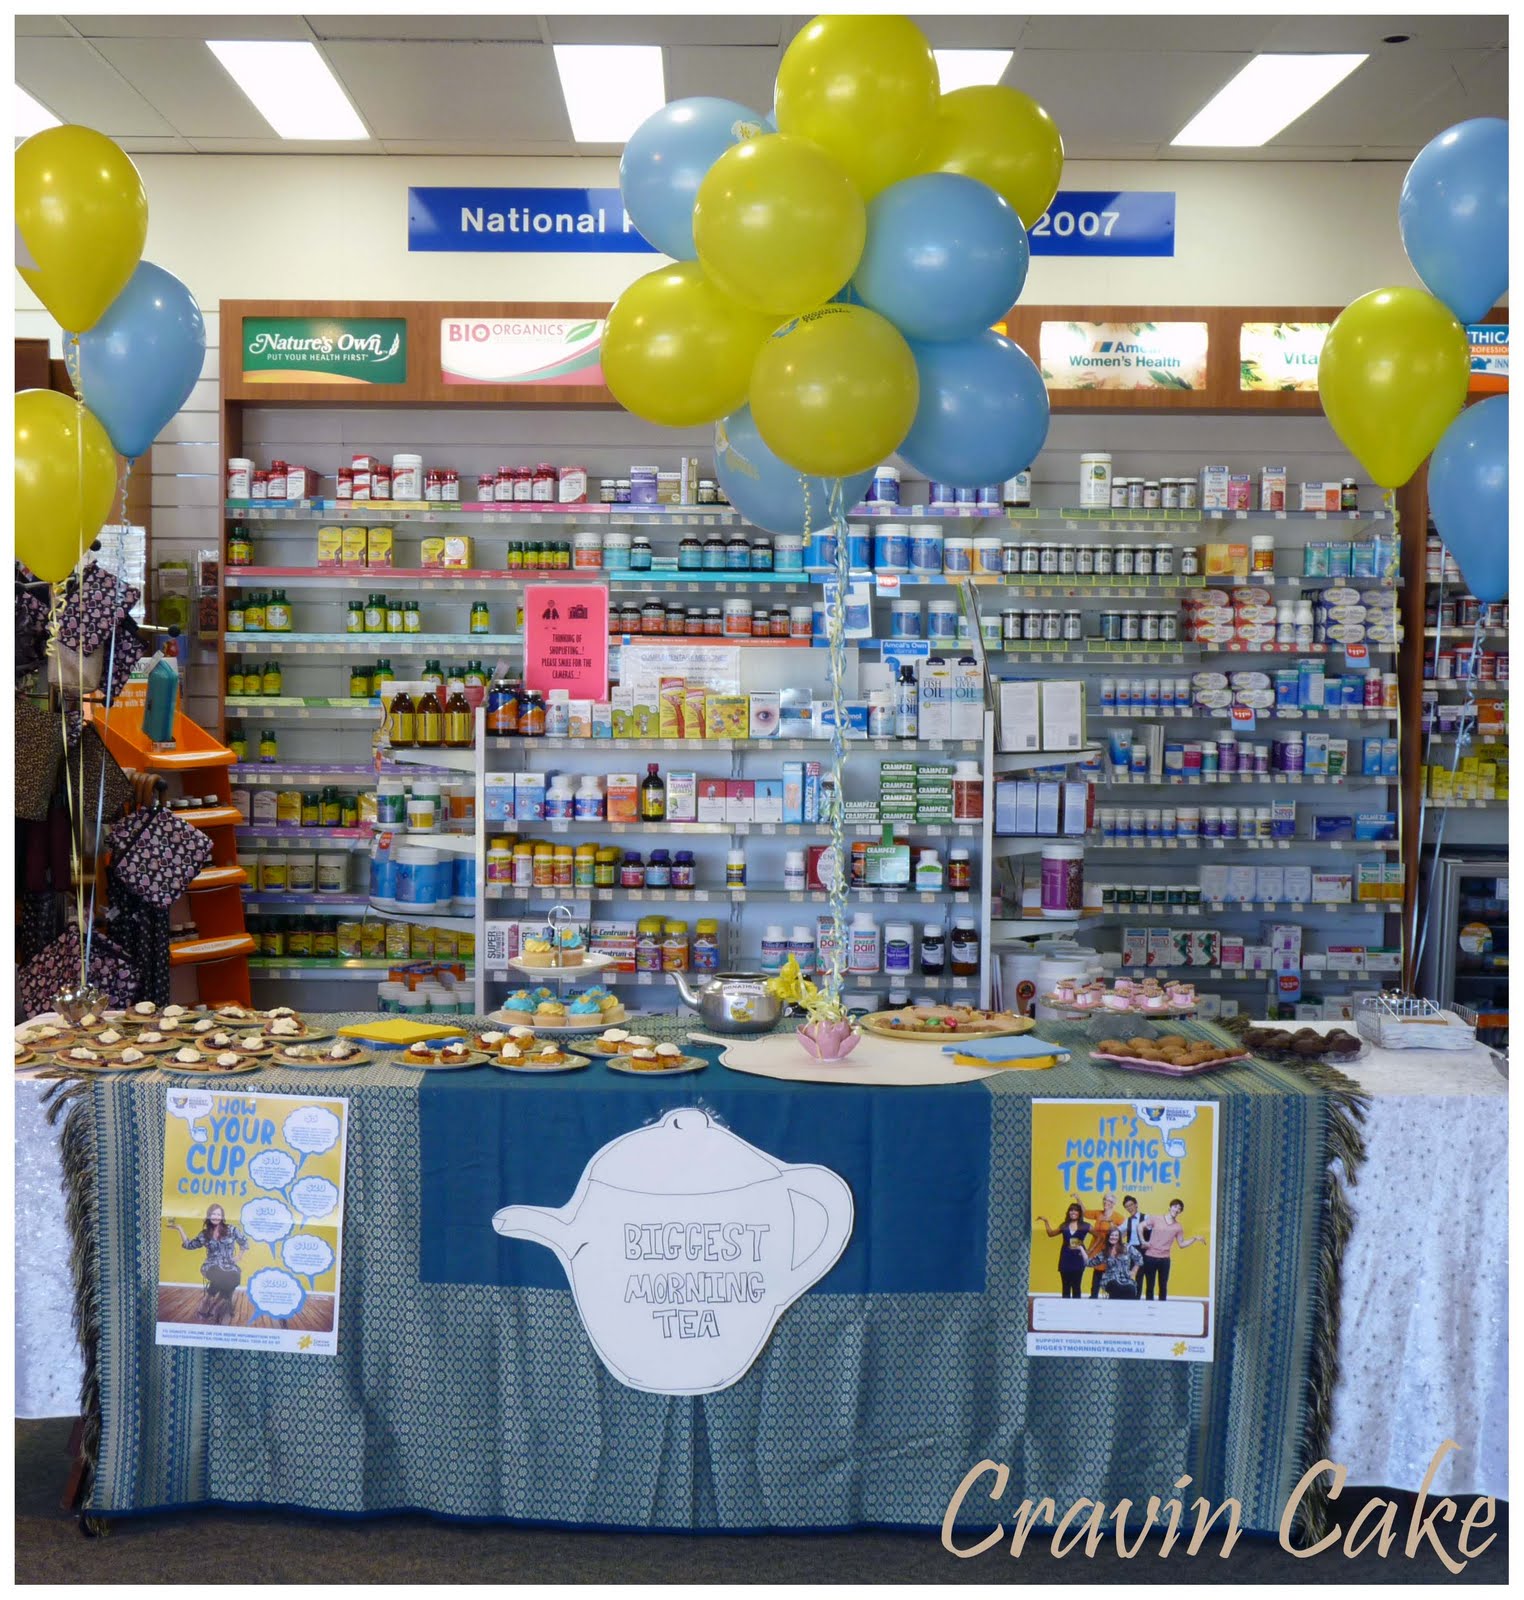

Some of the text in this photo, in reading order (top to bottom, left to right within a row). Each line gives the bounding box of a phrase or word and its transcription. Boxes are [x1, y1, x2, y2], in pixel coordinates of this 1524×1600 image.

[460, 206, 605, 233] National
[1032, 211, 1120, 237] 2007
[449, 324, 491, 342] BIO
[492, 324, 564, 335] ORGANICS
[249, 333, 383, 355] Nature's Own
[267, 353, 282, 361] PUT
[286, 353, 307, 361] YOUR
[310, 353, 340, 361] HEALTH
[1069, 355, 1181, 368] Women's Health
[923, 680, 942, 688] FISH
[923, 687, 945, 699] OIL
[955, 687, 977, 699] OIL
[599, 928, 629, 936] Centrum
[487, 930, 496, 959] SUPER
[854, 943, 876, 953] pain
[217, 1098, 257, 1116] HOW
[210, 1116, 276, 1145] YOUR
[1099, 1115, 1138, 1137] IT'S
[1066, 1137, 1159, 1159] MORNING
[186, 1143, 246, 1177] CUP
[178, 1177, 248, 1196] COUNTS
[294, 1242, 319, 1251] $100
[624, 1222, 770, 1262] BIGGEST
[262, 1279, 288, 1288] $200
[624, 1271, 765, 1304] MORNING
[652, 1308, 720, 1339] TEA
